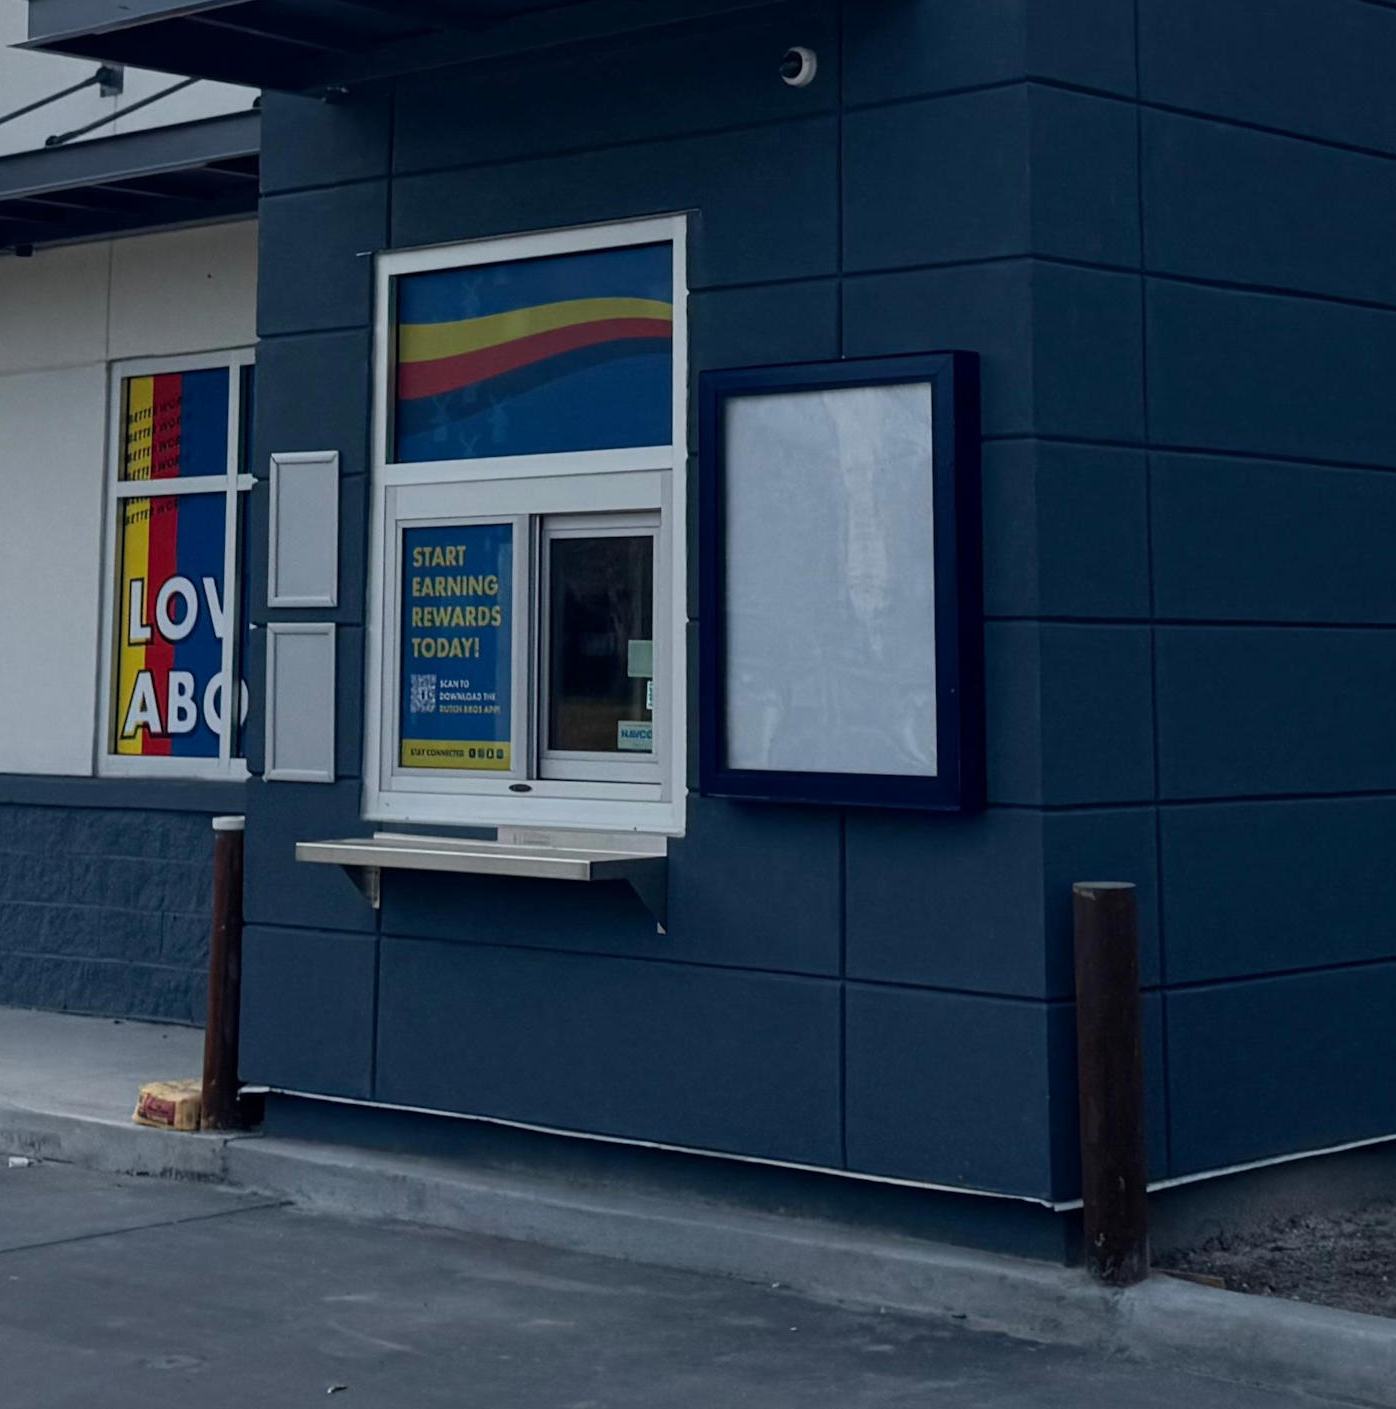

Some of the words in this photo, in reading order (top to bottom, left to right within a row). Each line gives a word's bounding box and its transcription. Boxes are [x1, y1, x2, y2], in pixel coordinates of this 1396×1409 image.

[412, 545, 466, 567] START
[412, 574, 499, 597] EARNING
[412, 605, 502, 627] REWARDS
[412, 637, 480, 658] TODAY!
[439, 679, 459, 688] SCAN
[460, 679, 470, 688] TO
